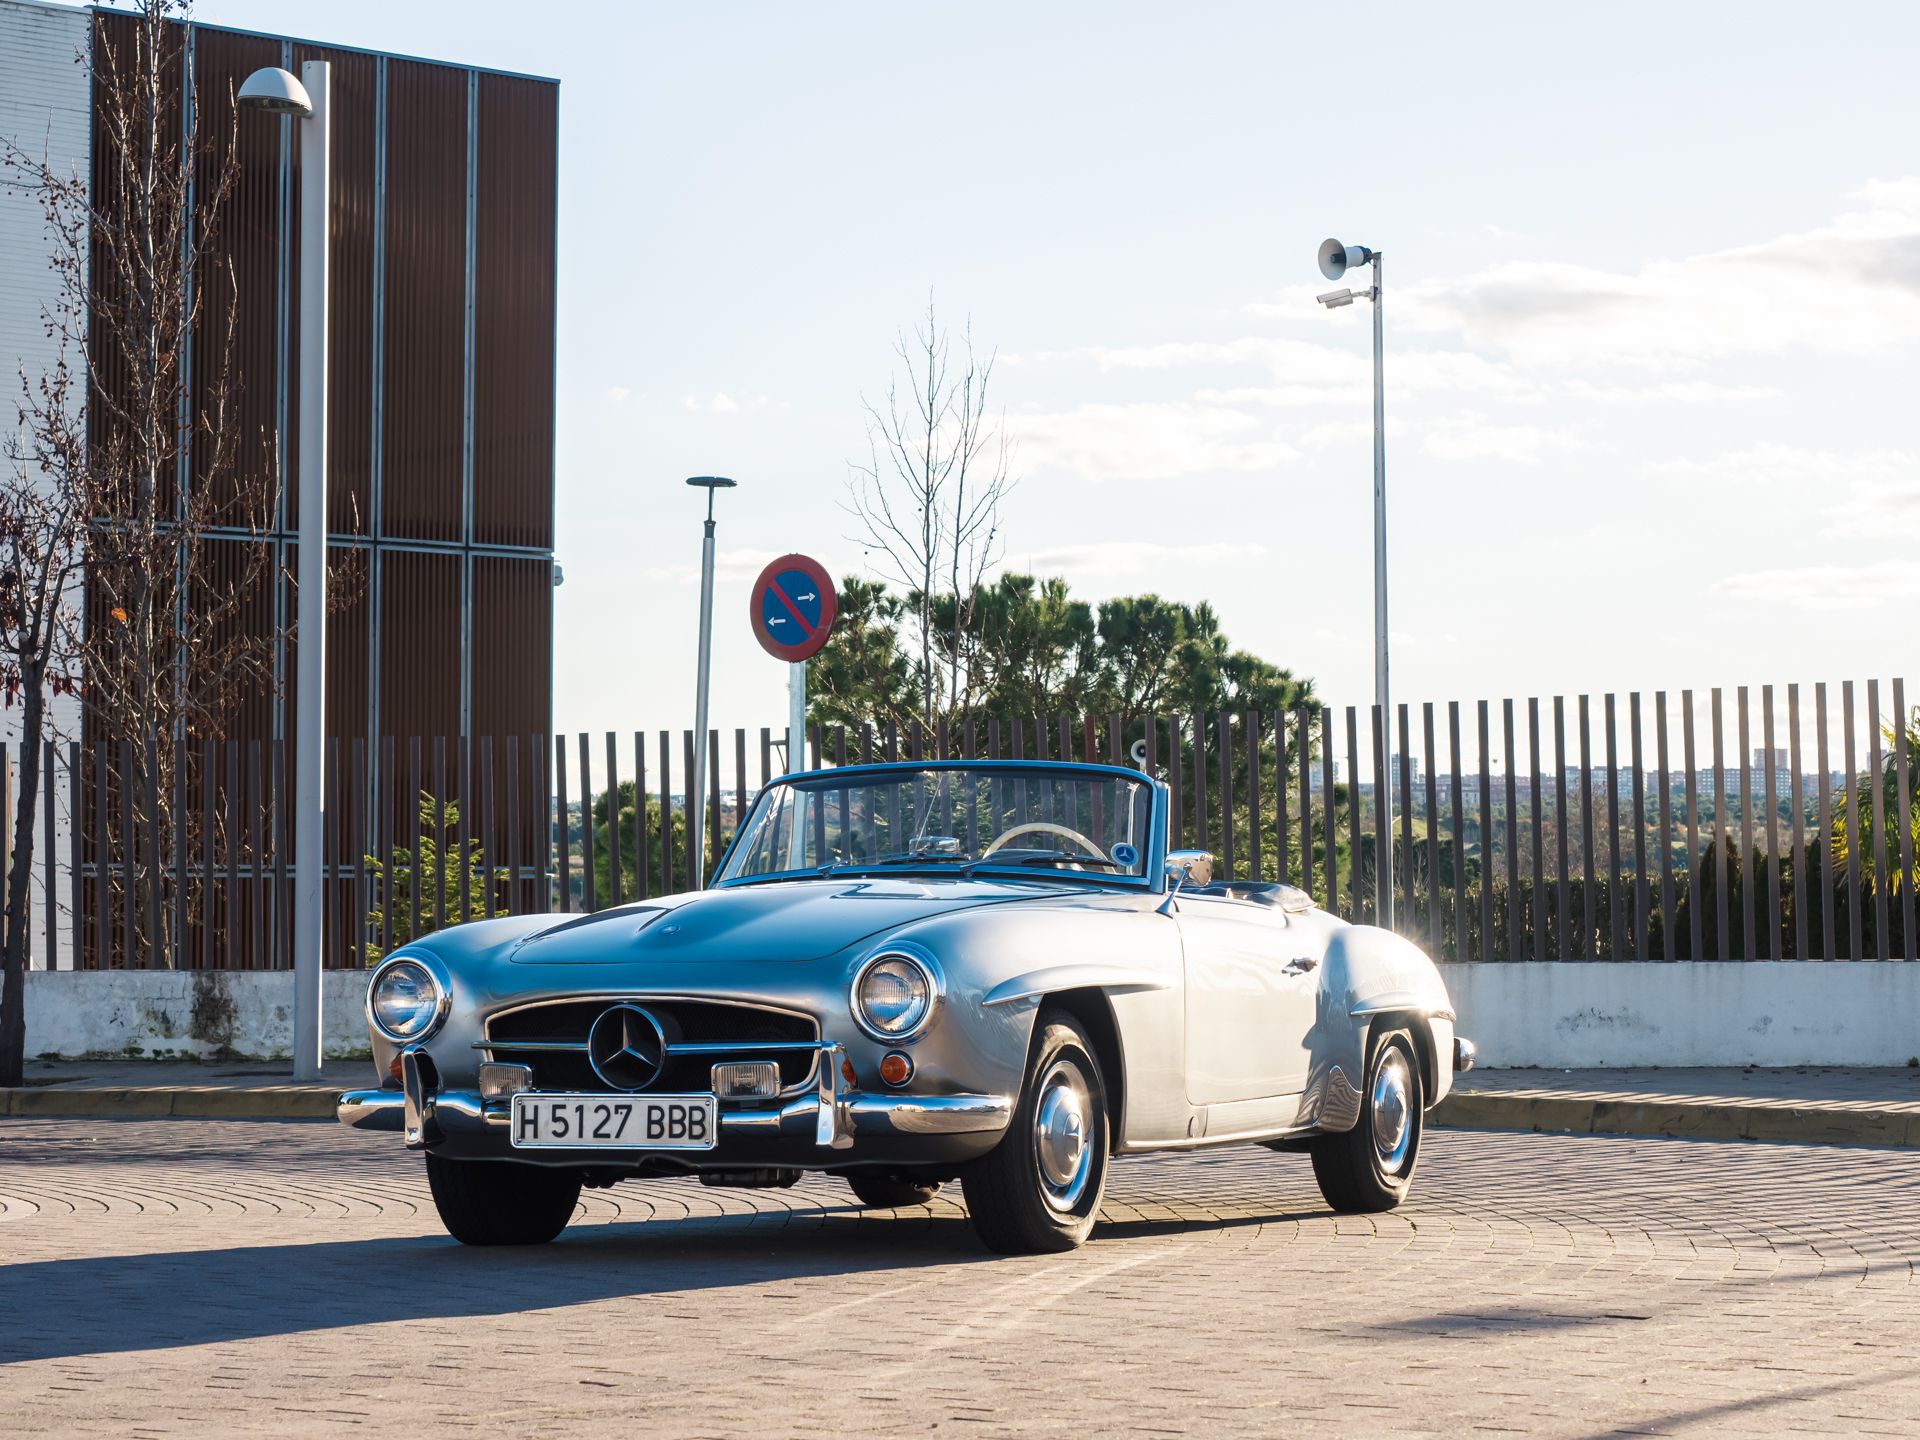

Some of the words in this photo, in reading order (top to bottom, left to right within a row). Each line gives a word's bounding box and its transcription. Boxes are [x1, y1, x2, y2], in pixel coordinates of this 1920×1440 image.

[520, 1104, 539, 1139] H
[551, 1104, 632, 1139] 5127
[646, 1105, 706, 1140] BBB
